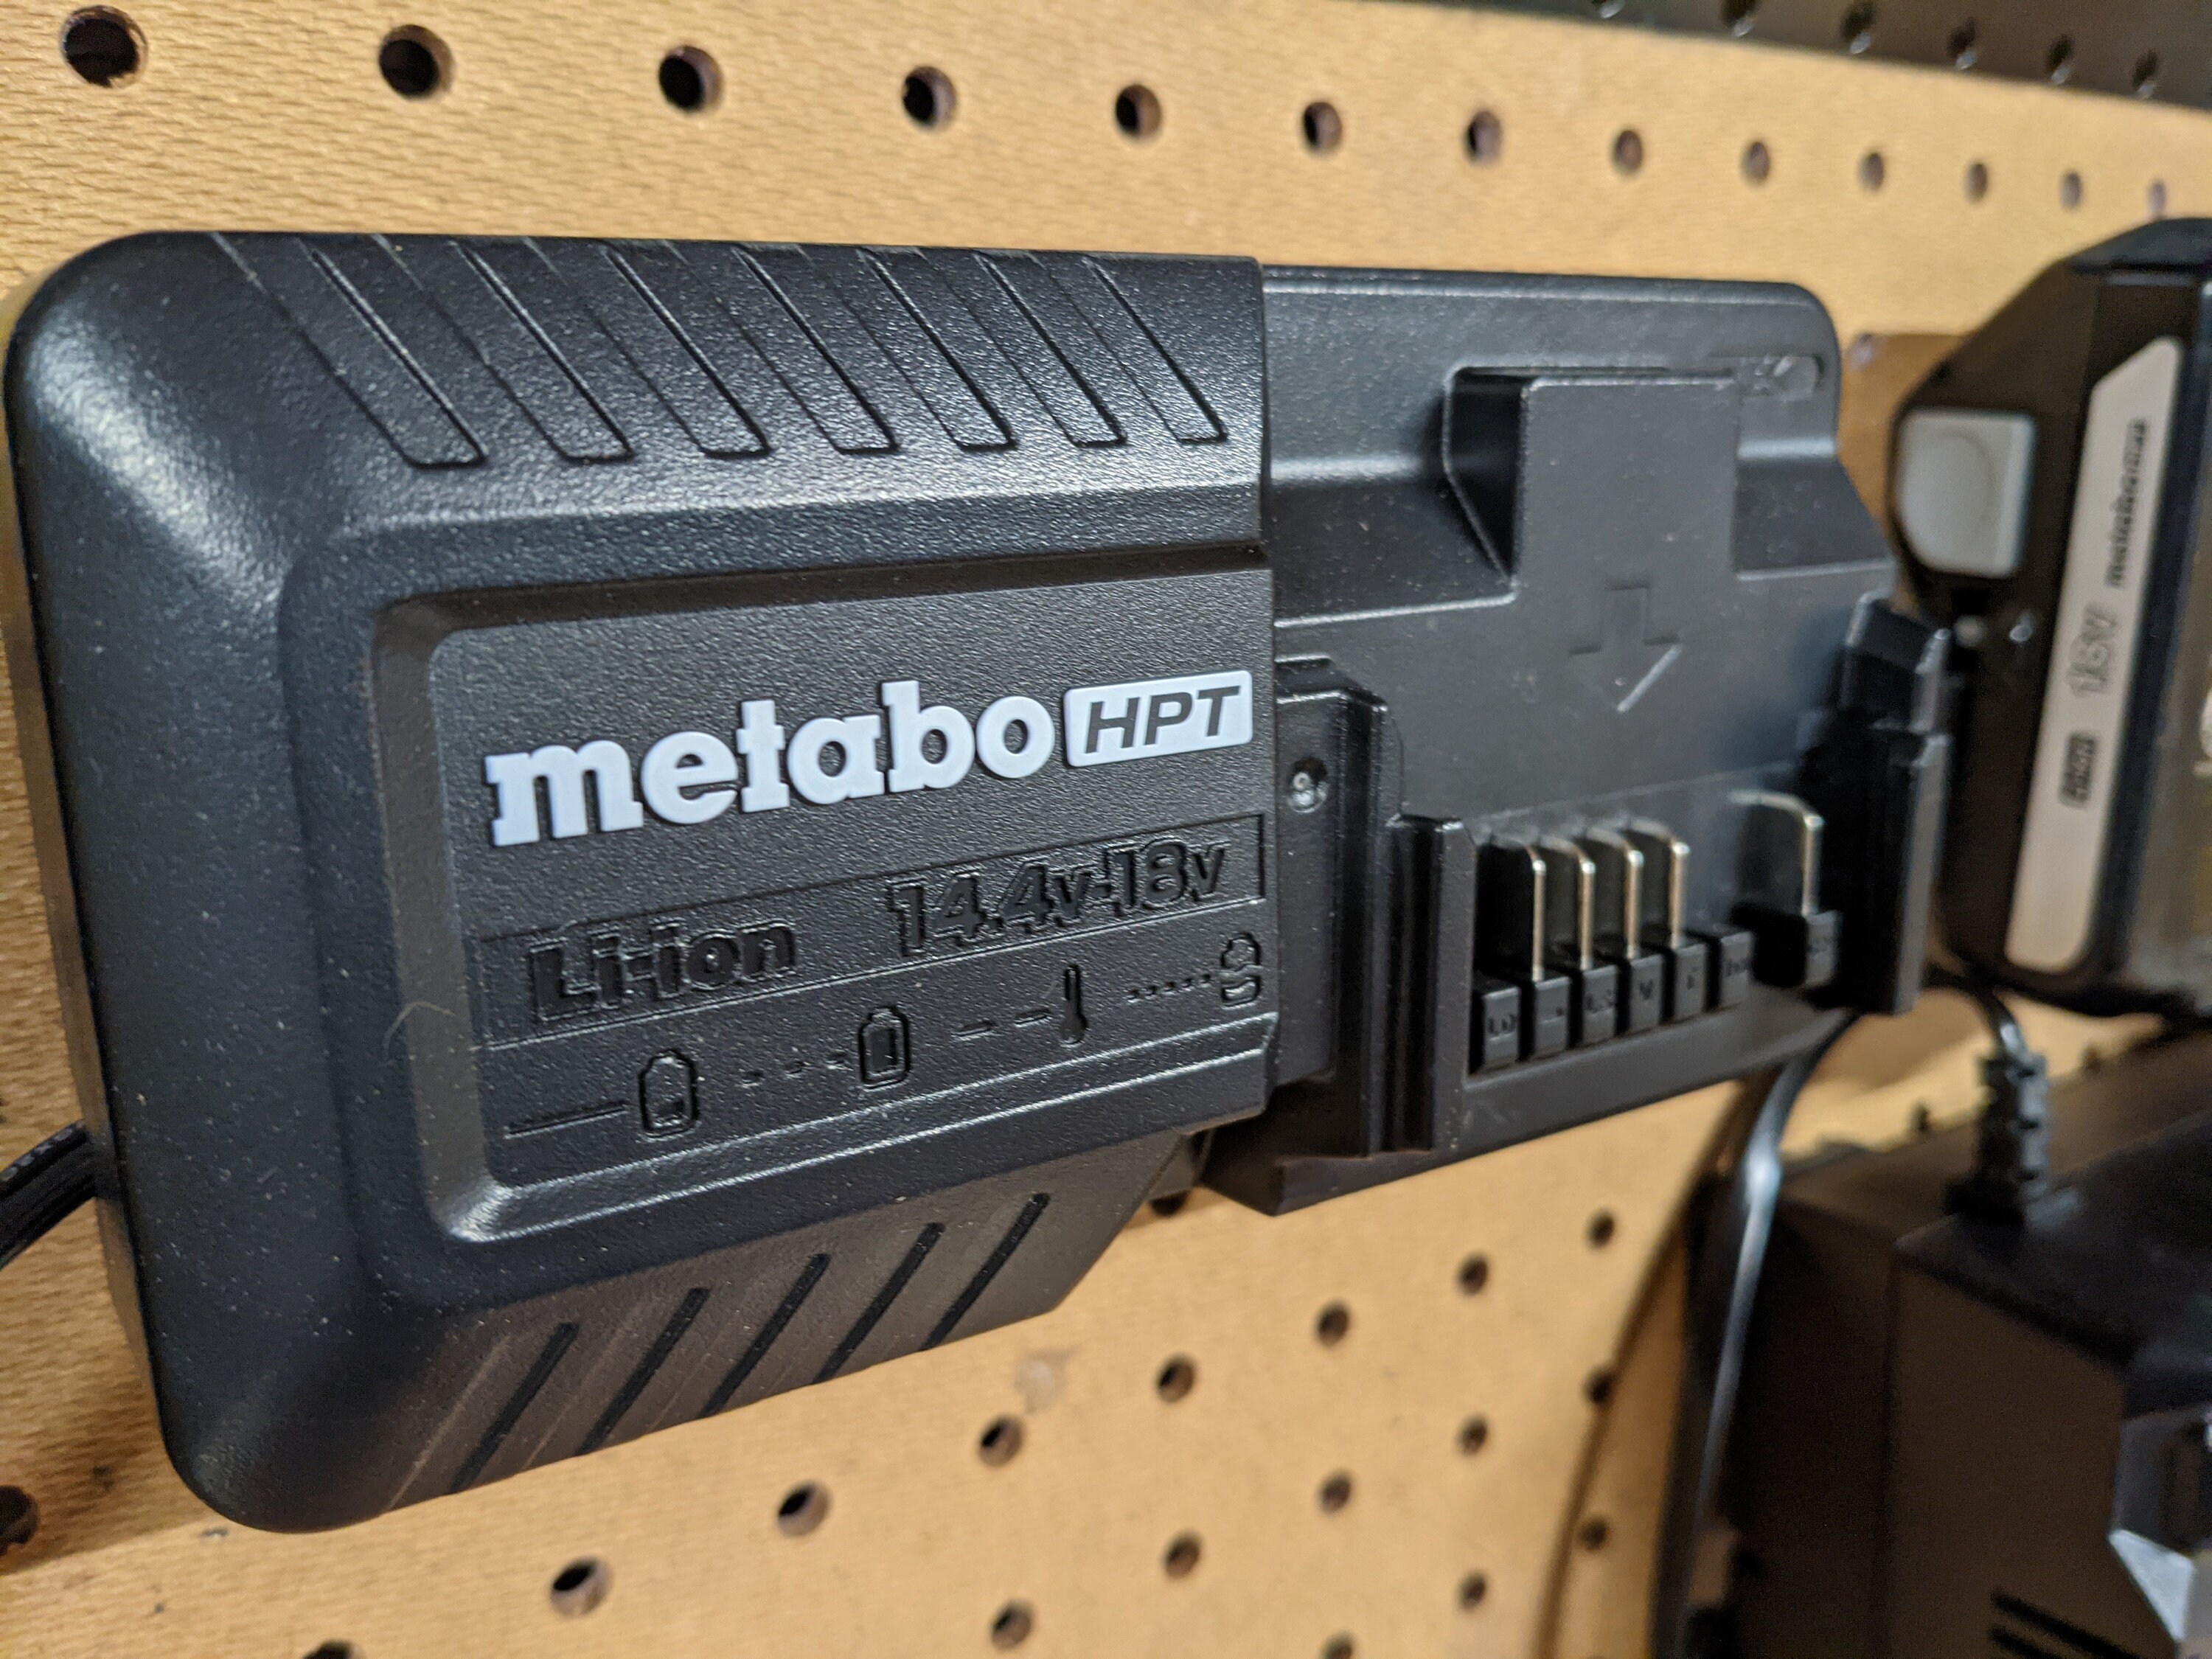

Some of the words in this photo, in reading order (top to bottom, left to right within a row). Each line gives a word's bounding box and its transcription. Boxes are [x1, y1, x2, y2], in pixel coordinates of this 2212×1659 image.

[484, 680, 1055, 846] metabo
[1081, 682, 1245, 757] HPT
[529, 919, 797, 1022] Li-ion
